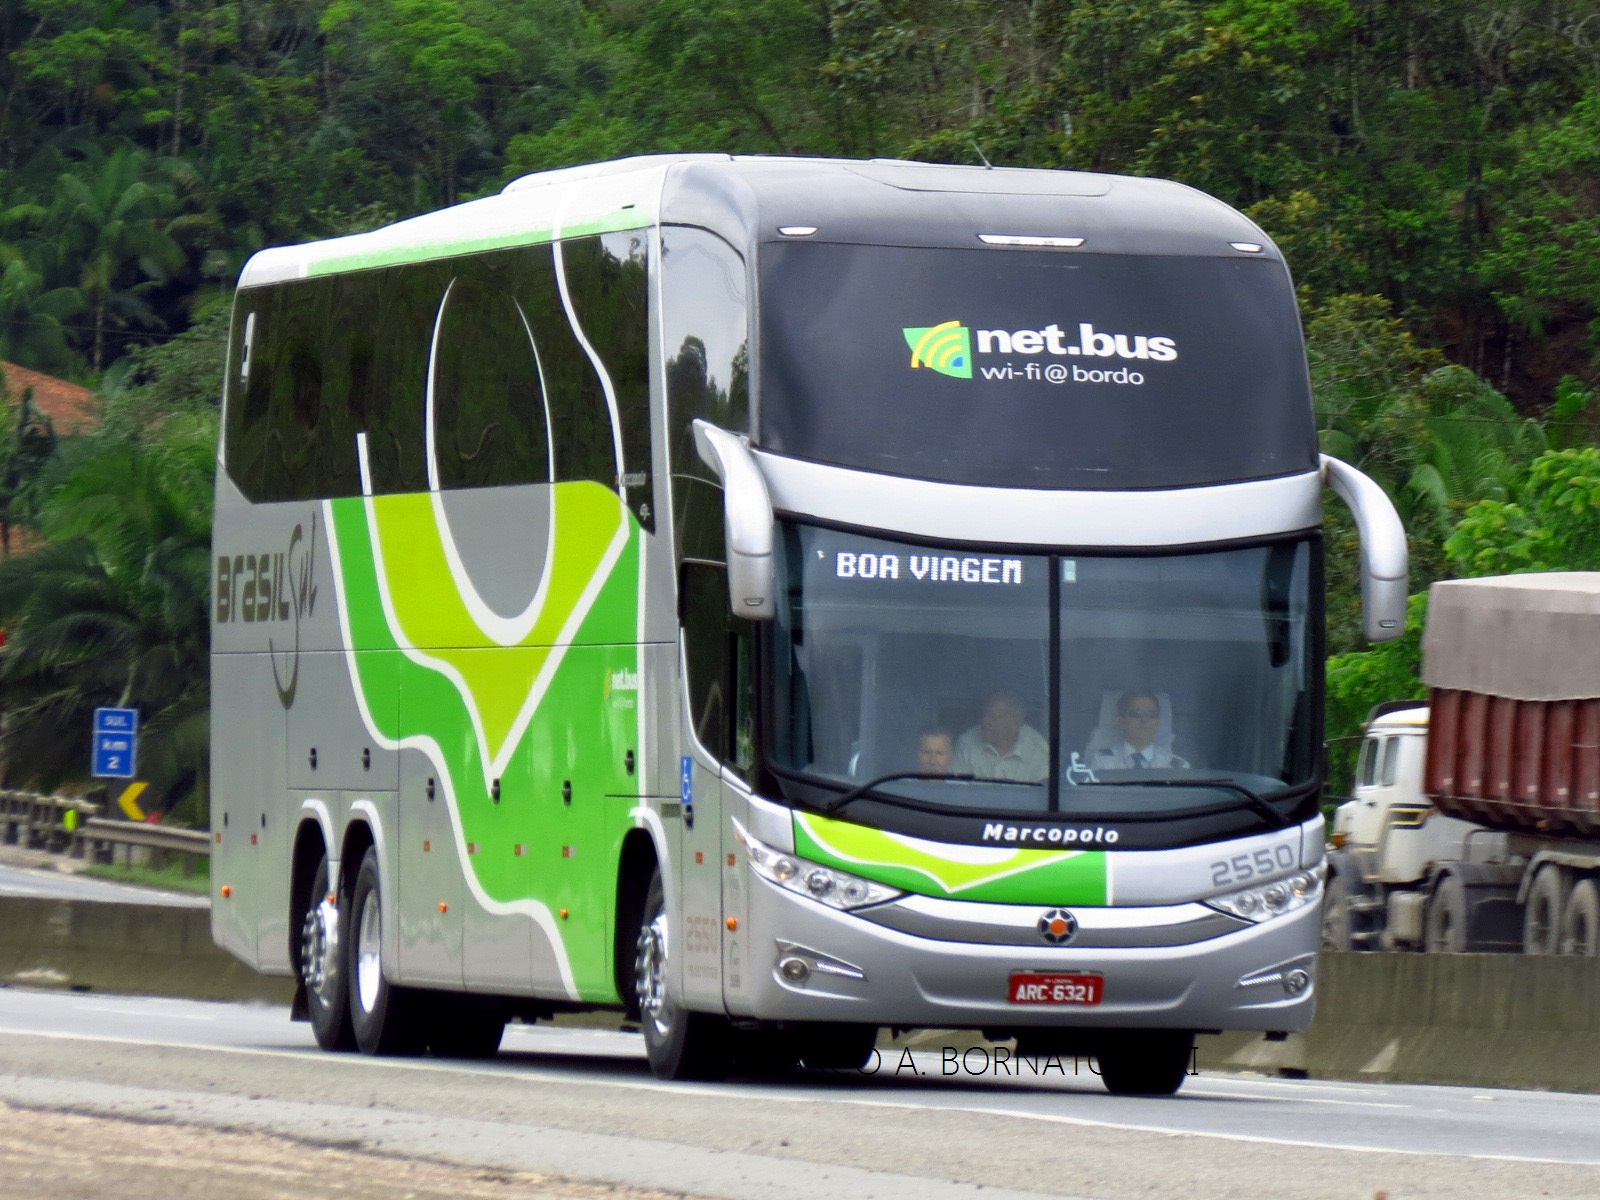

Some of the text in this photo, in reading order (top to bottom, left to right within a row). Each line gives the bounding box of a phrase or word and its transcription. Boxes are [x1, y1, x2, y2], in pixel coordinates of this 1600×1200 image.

[976, 323, 1178, 361] net.bus
[836, 552, 1022, 584] BOA VIAGEM
[107, 756, 120, 769] 2
[983, 823, 1119, 844] Marcopolo
[1210, 844, 1295, 887] 2550
